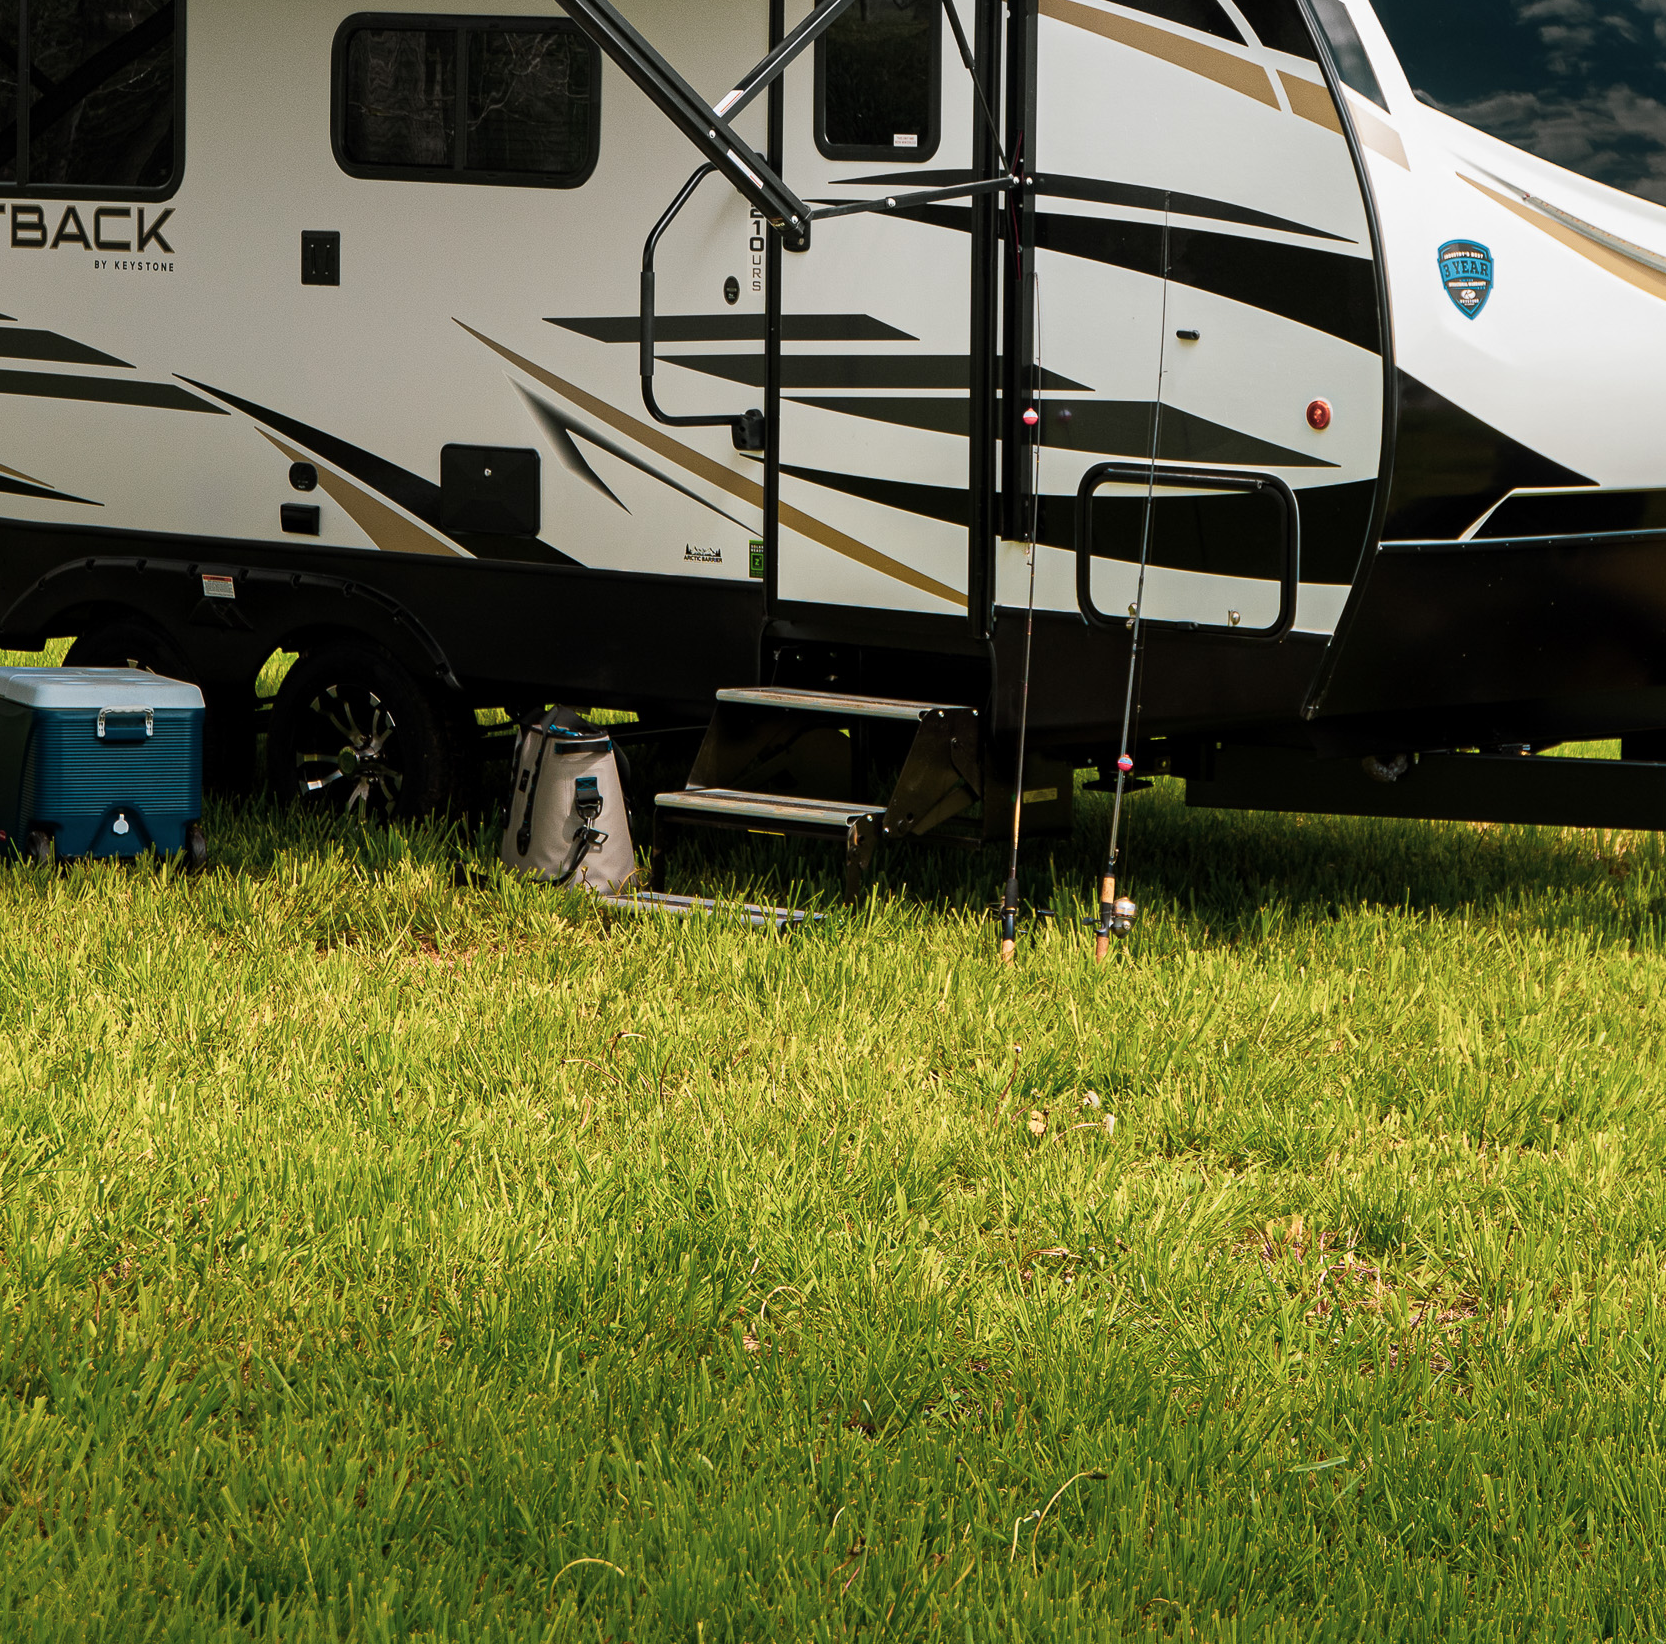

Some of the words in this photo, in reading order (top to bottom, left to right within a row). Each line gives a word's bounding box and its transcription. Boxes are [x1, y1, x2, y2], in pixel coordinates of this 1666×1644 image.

[94, 260, 107, 270] BY
[114, 260, 174, 272] KEYSTONE
[1443, 264, 1451, 277] 3
[1452, 260, 1489, 276] YEAR
